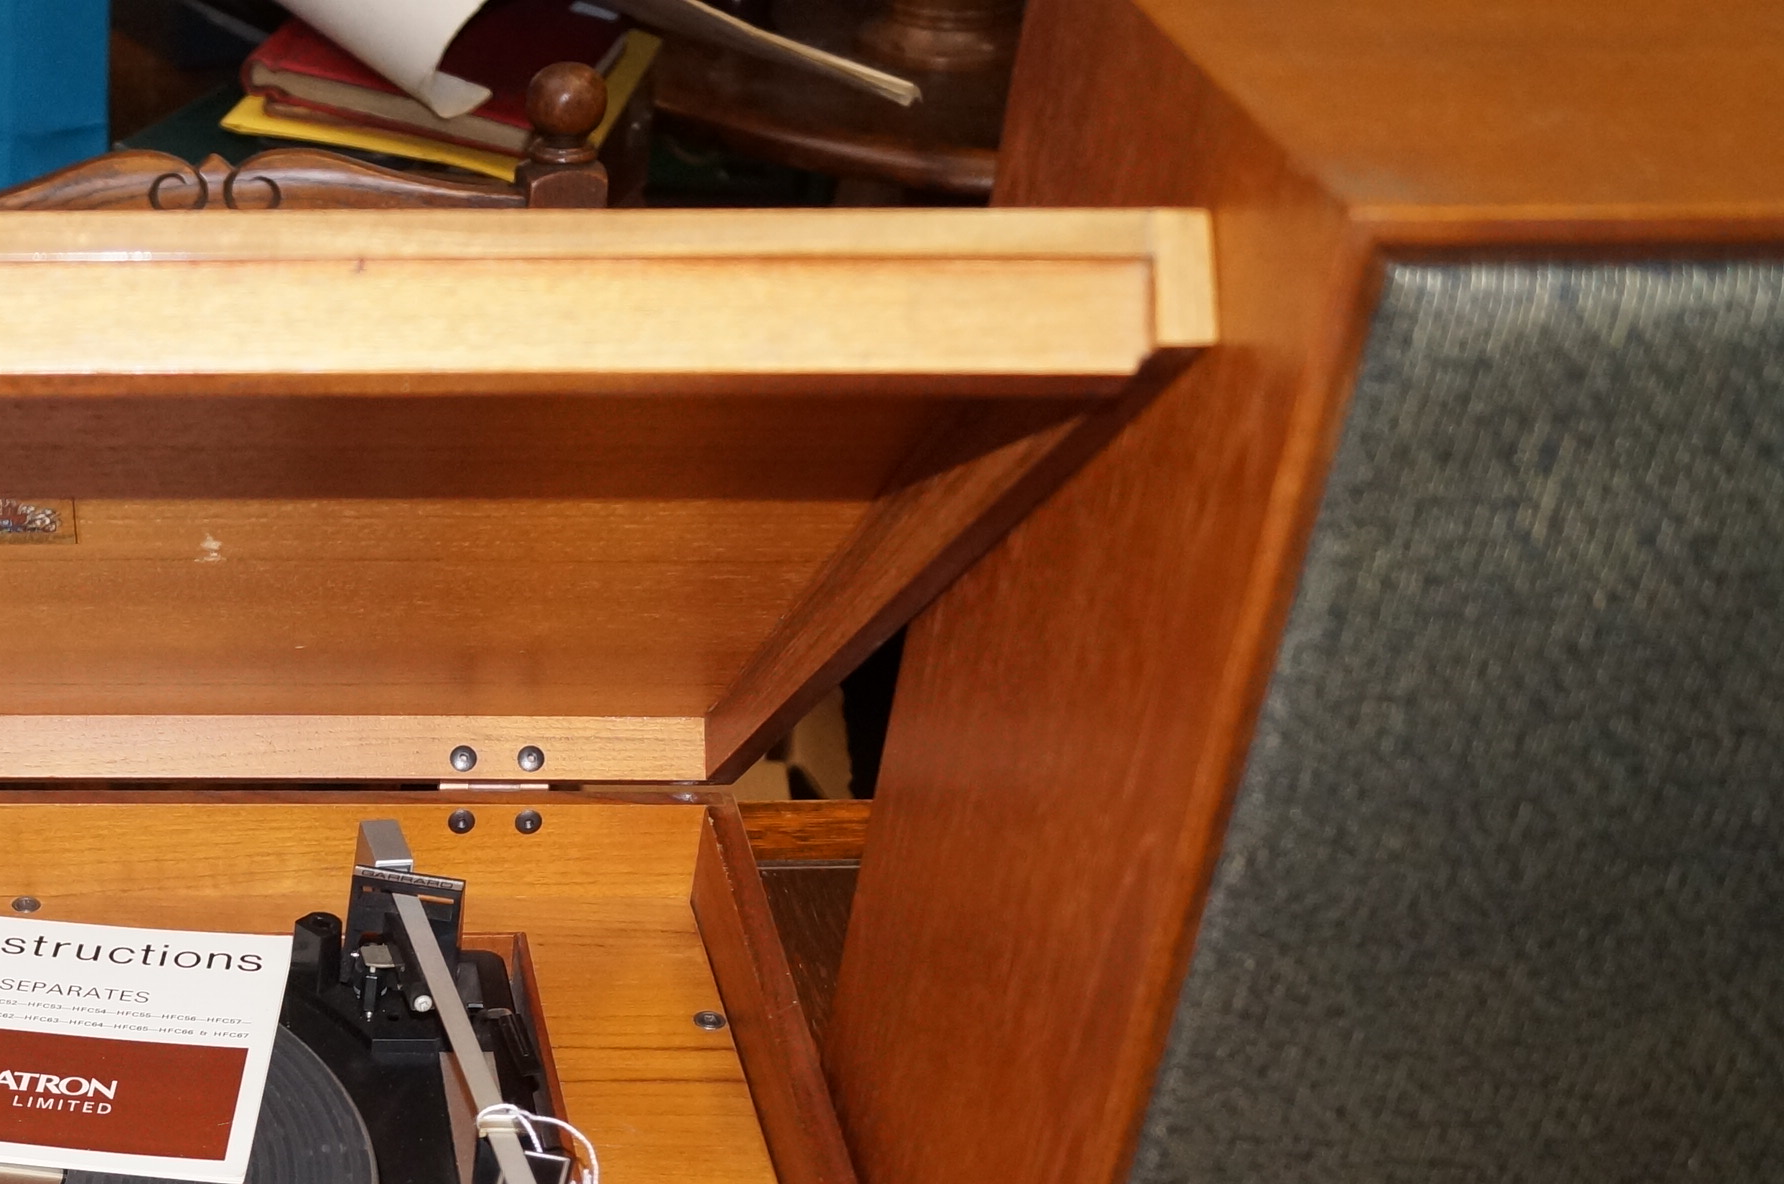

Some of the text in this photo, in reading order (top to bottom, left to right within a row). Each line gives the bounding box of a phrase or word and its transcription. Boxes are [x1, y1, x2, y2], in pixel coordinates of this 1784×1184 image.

[361, 869, 454, 889] GARRARD
[0, 978, 151, 1004] SEPARATES
[213, 1031, 250, 1039] HFC67
[12, 1095, 112, 1115] LIMITED
